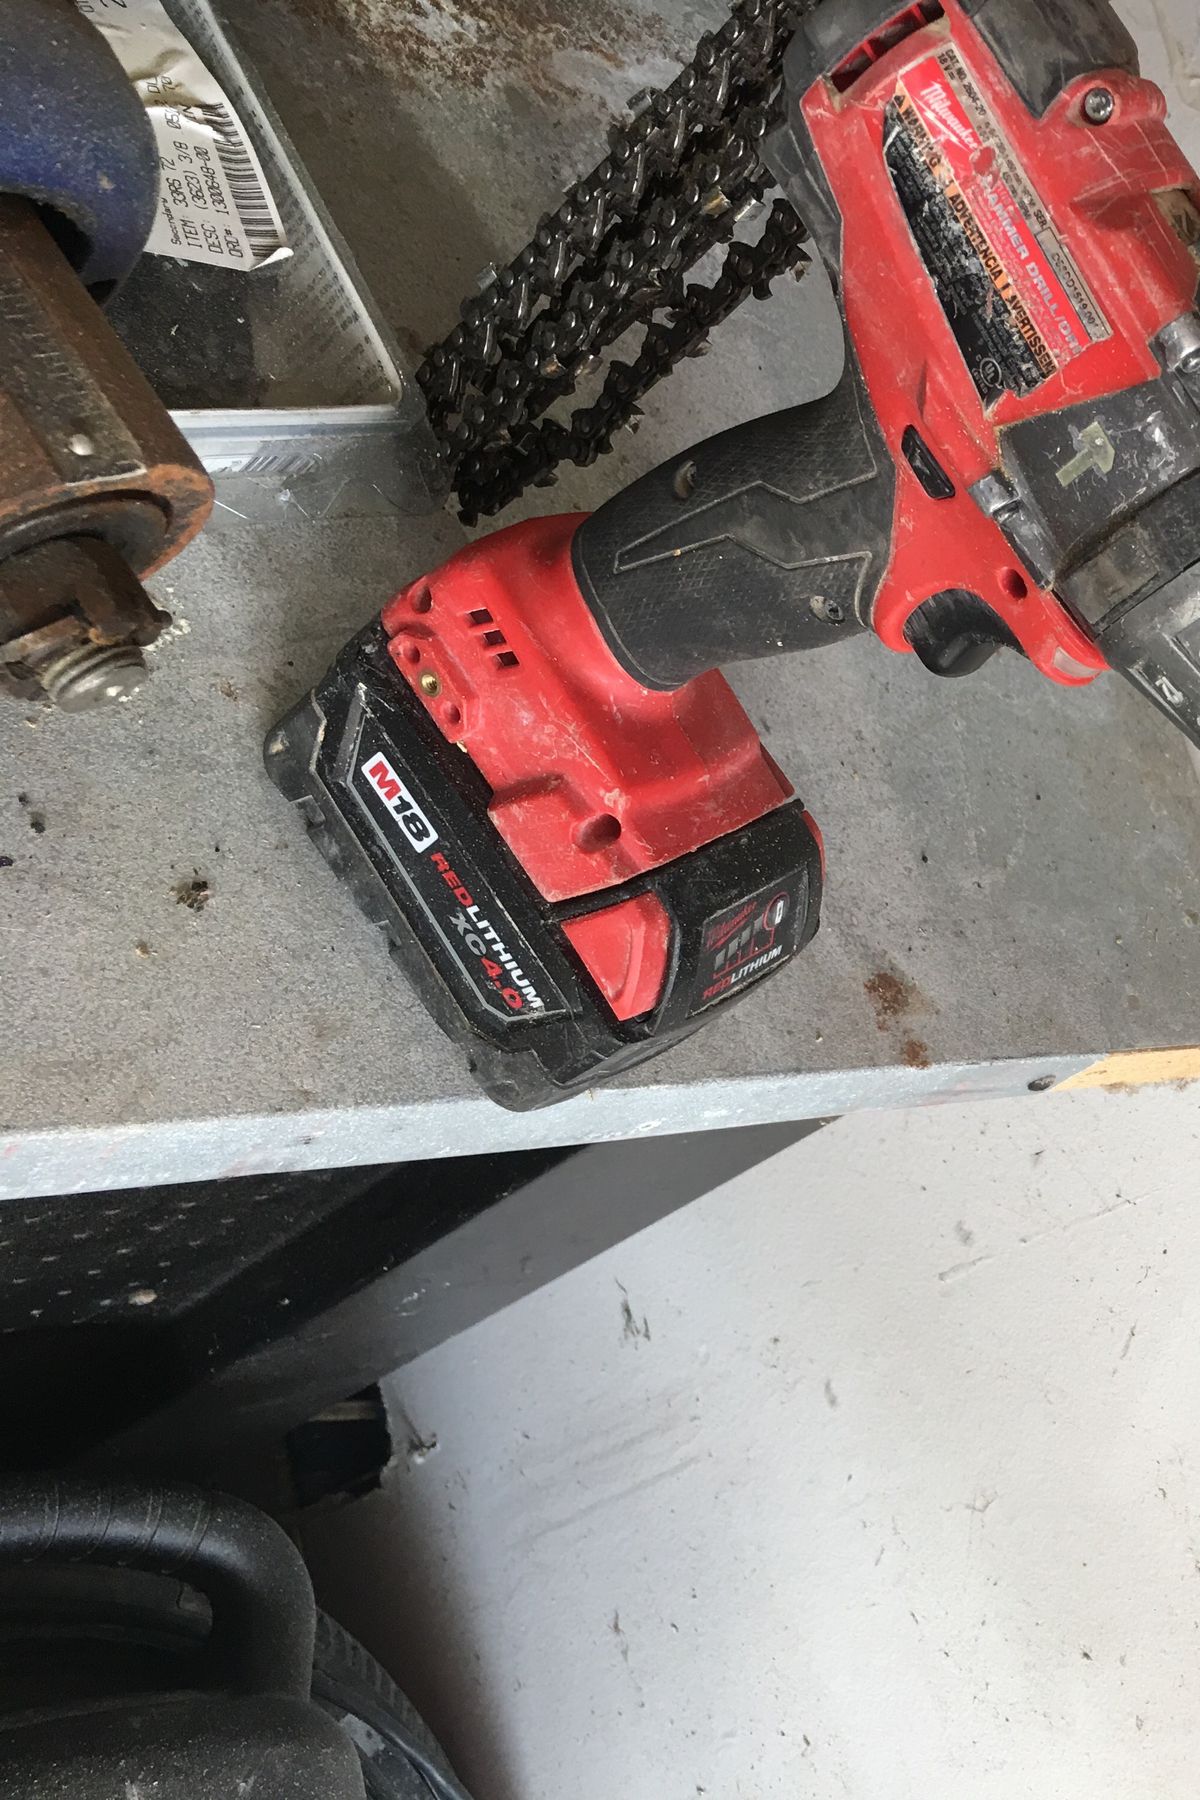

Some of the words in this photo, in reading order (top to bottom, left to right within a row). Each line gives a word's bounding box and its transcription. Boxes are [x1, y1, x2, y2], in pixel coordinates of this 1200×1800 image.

[920, 81, 977, 149] Milwaukee
[160, 157, 176, 171] 72
[173, 141, 192, 164] 3/8
[166, 177, 188, 207] 33RS
[183, 170, 208, 210] (3623)
[948, 190, 1006, 281] ADVERTENCIA
[369, 760, 432, 842] M18
[430, 852, 545, 1008] REDLITHIUM
[449, 908, 524, 1009] XC4.0
[703, 945, 783, 1000] REDLITHIUM
